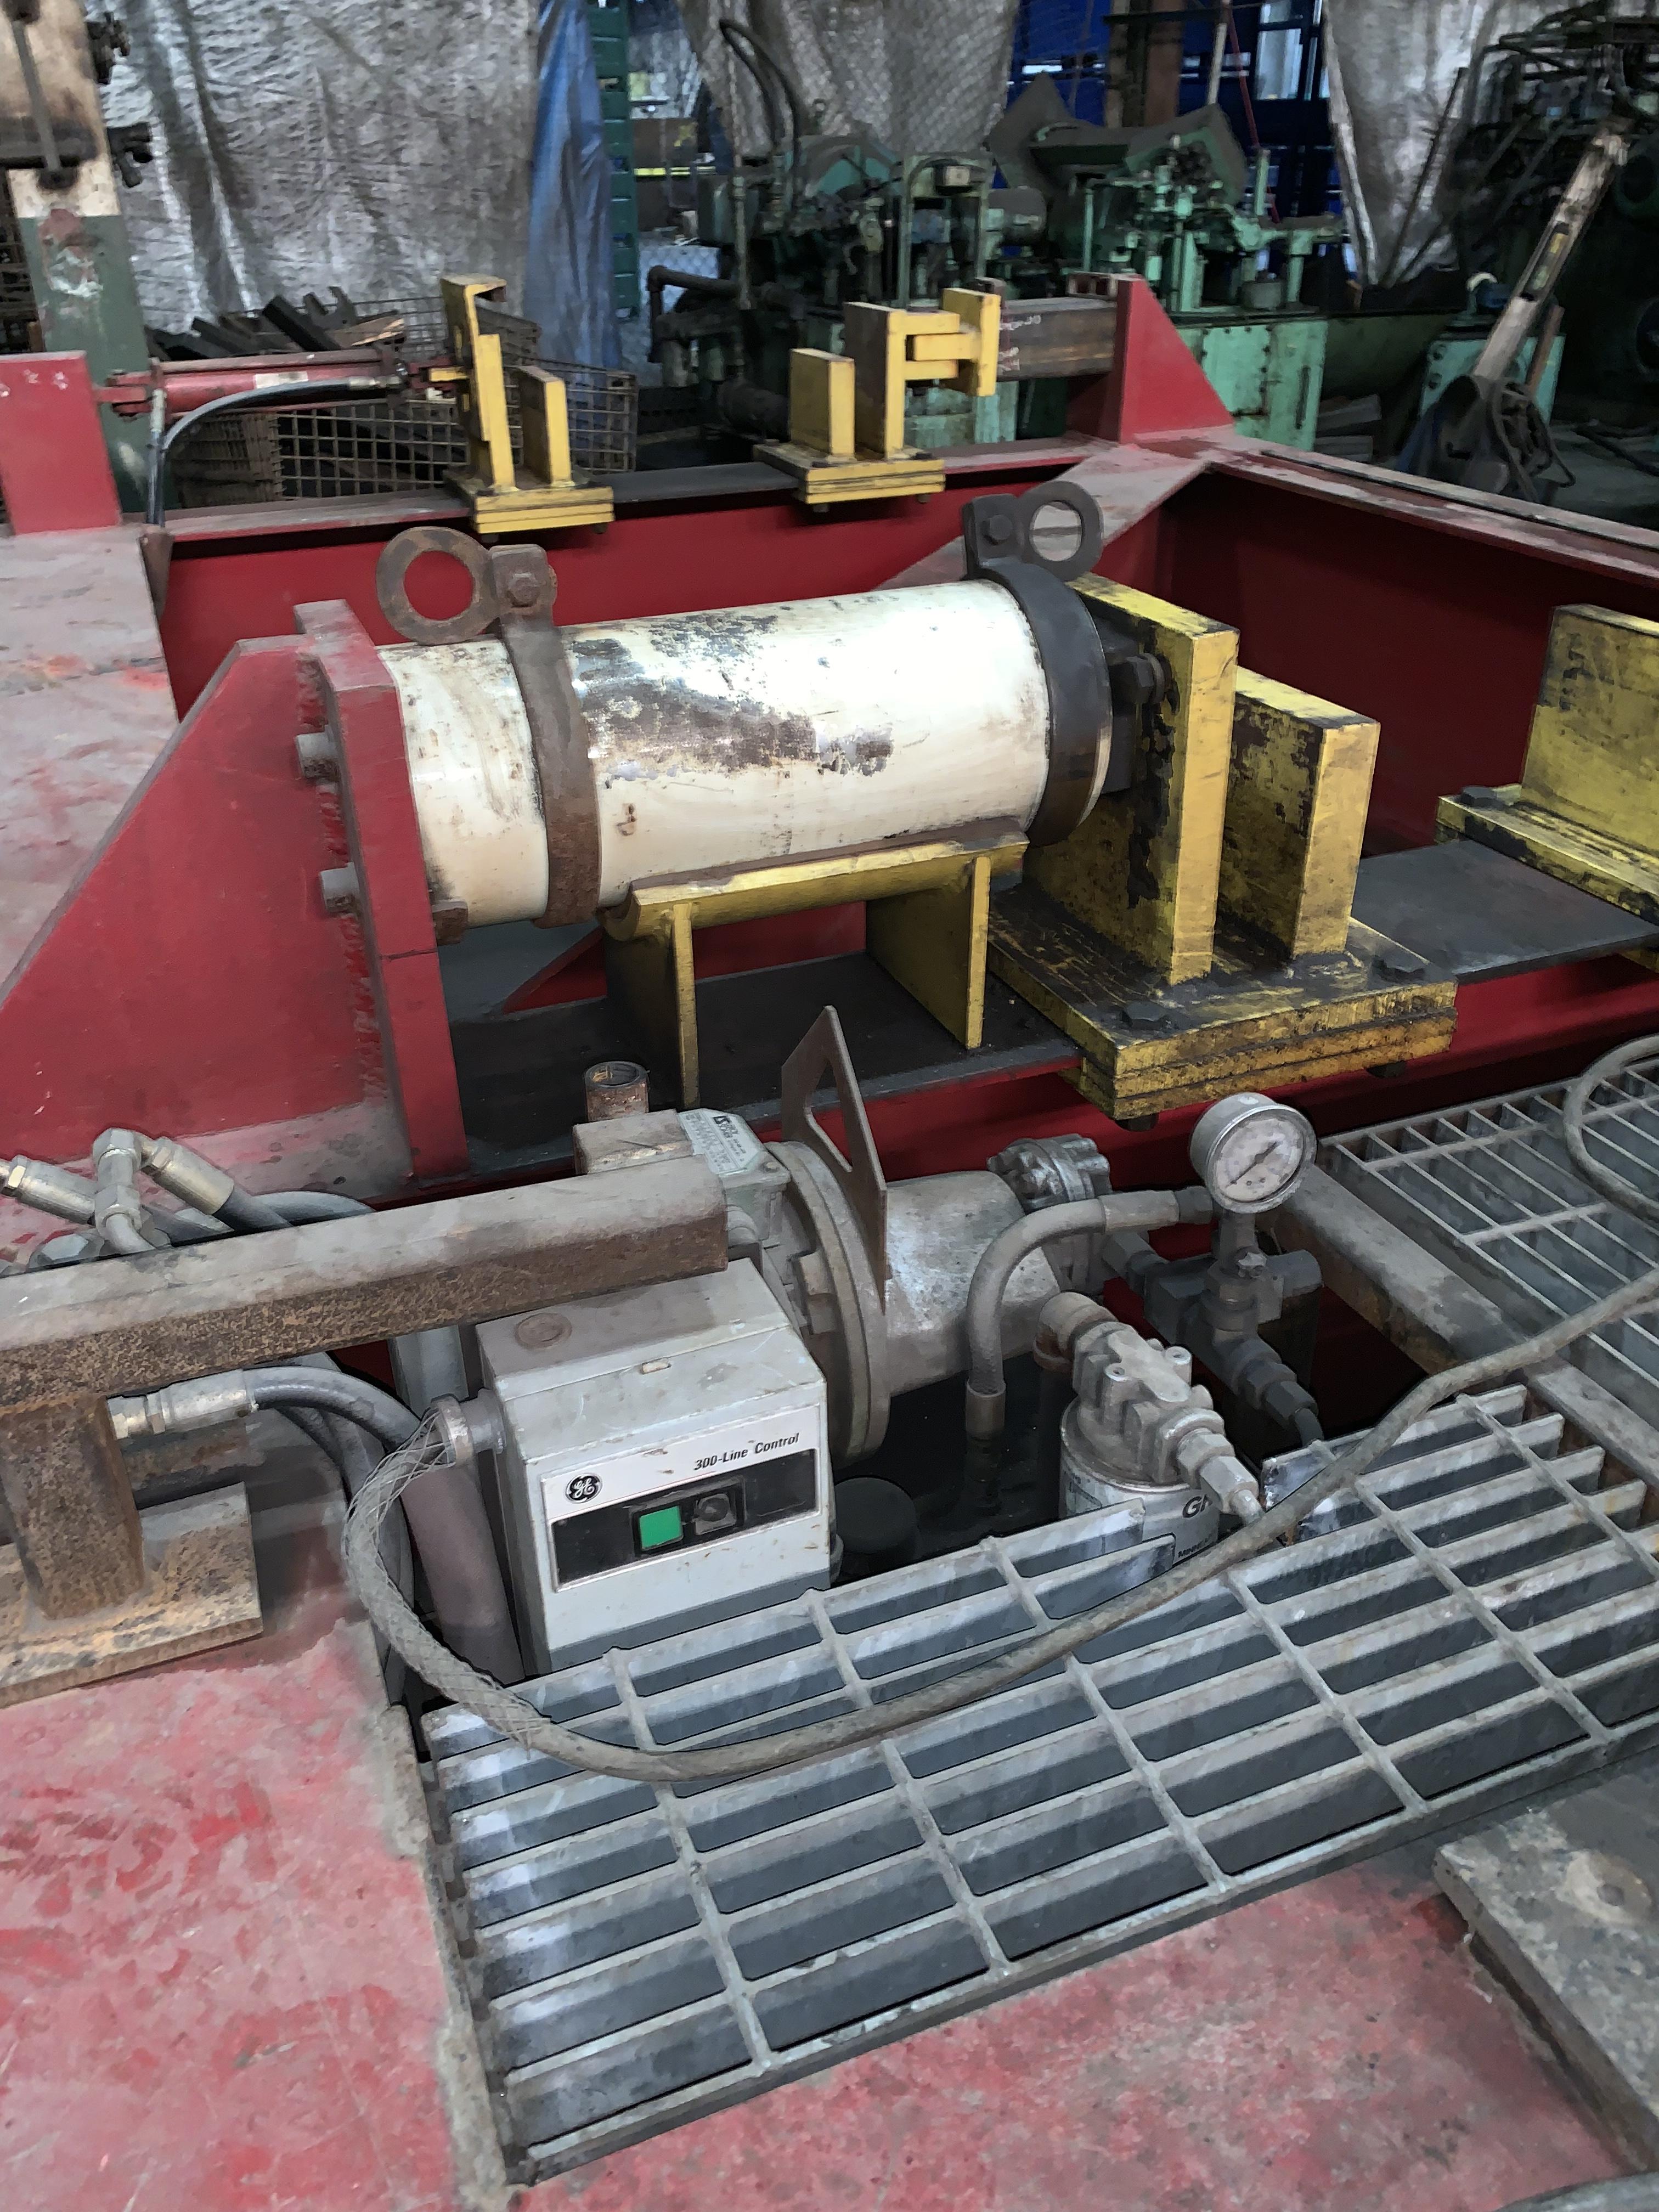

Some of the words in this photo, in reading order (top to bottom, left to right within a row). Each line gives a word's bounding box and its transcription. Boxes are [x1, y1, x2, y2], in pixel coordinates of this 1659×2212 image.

[694, 1448, 748, 1471] 300-Line
[754, 1432, 800, 1454] Control
[571, 1475, 599, 1500] GE
